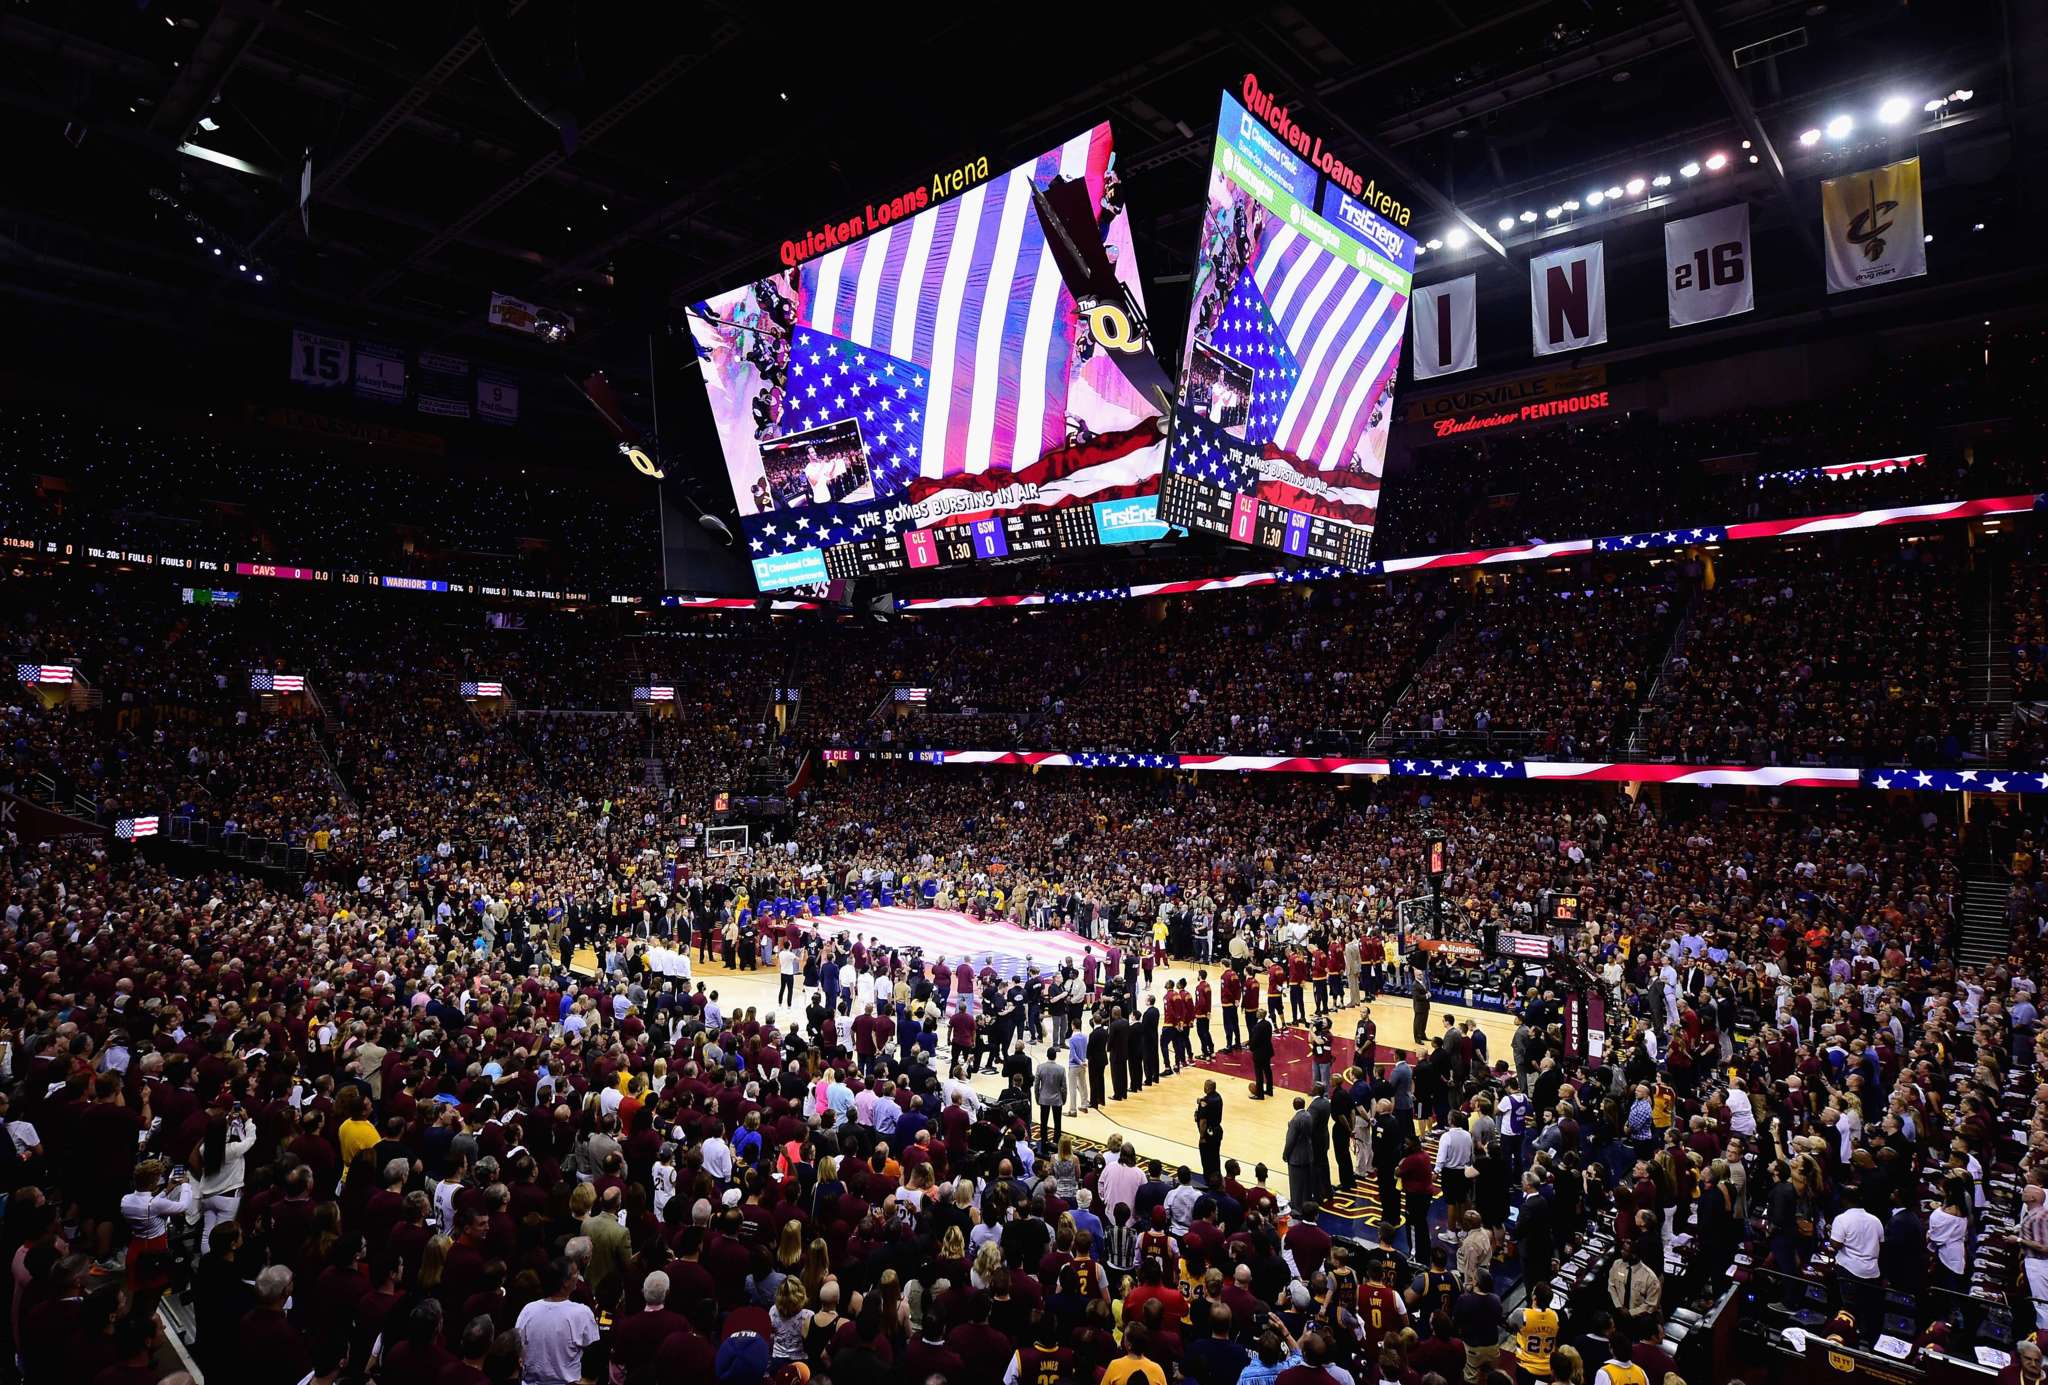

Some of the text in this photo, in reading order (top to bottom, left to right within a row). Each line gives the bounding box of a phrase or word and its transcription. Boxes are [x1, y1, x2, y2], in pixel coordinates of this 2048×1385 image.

[1242, 73, 1411, 227] Quicken Loans Arena
[780, 155, 989, 266] Quicken Loans Arena
[1674, 240, 1745, 292] 216
[1855, 272, 1875, 282] drug
[1875, 267, 1896, 278] mart
[1077, 300, 1097, 312] The
[1546, 259, 1590, 345] N
[1089, 304, 1143, 353] Q
[1437, 293, 1452, 367] I
[303, 346, 340, 381] 15
[1433, 391, 1610, 438] Budweiser PENTHOUSE
[628, 449, 665, 479] Q
[1229, 448, 1243, 464] THE
[1244, 454, 1271, 475] BOMBS
[1270, 463, 1305, 488] BURSTING
[1315, 479, 1329, 496] AIR
[857, 483, 1041, 528] THE BOMBS BURSTING IN AIR
[1240, 497, 1253, 514] CLE
[977, 521, 995, 535] GSW
[1238, 515, 1247, 538] 0
[1291, 512, 1307, 529] GSW
[912, 533, 926, 545] CLE
[959, 525, 972, 537] 0.0
[1262, 526, 1282, 548] 1:30
[2, 537, 35, 549] $10,949
[985, 536, 995, 555] 0
[1291, 529, 1300, 552] 0
[65, 544, 73, 555] 0
[88, 547, 105, 558] TOL:
[106, 550, 120, 560] 20s
[121, 551, 126, 561] 1
[127, 553, 146, 563] FULL
[917, 546, 928, 564] 0
[947, 542, 971, 561] 1:30
[160, 556, 193, 569] FOULS 0
[199, 561, 230, 572] FG% 0
[252, 564, 301, 579] CAVS 0
[315, 571, 329, 581] 0.0
[342, 573, 359, 584] 1:30
[368, 576, 379, 586] 1Q
[386, 577, 438, 591] WARRIORS 0
[450, 583, 474, 594] FG% 0
[482, 586, 507, 596] FOULS 0
[541, 591, 555, 600] FULL
[833, 750, 848, 761] CLE
[854, 751, 860, 761] 0
[880, 751, 892, 760] 1:30
[908, 751, 914, 761] 0
[919, 751, 935, 761] GSW
[1571, 1014, 1579, 1051] NBA TV
[1078, 1277, 1088, 1296] 2
[1369, 1297, 1382, 1307] LOVE
[1371, 1308, 1382, 1329] 0
[1527, 1335, 1555, 1354] 23
[1040, 1360, 1059, 1372] JAMES
